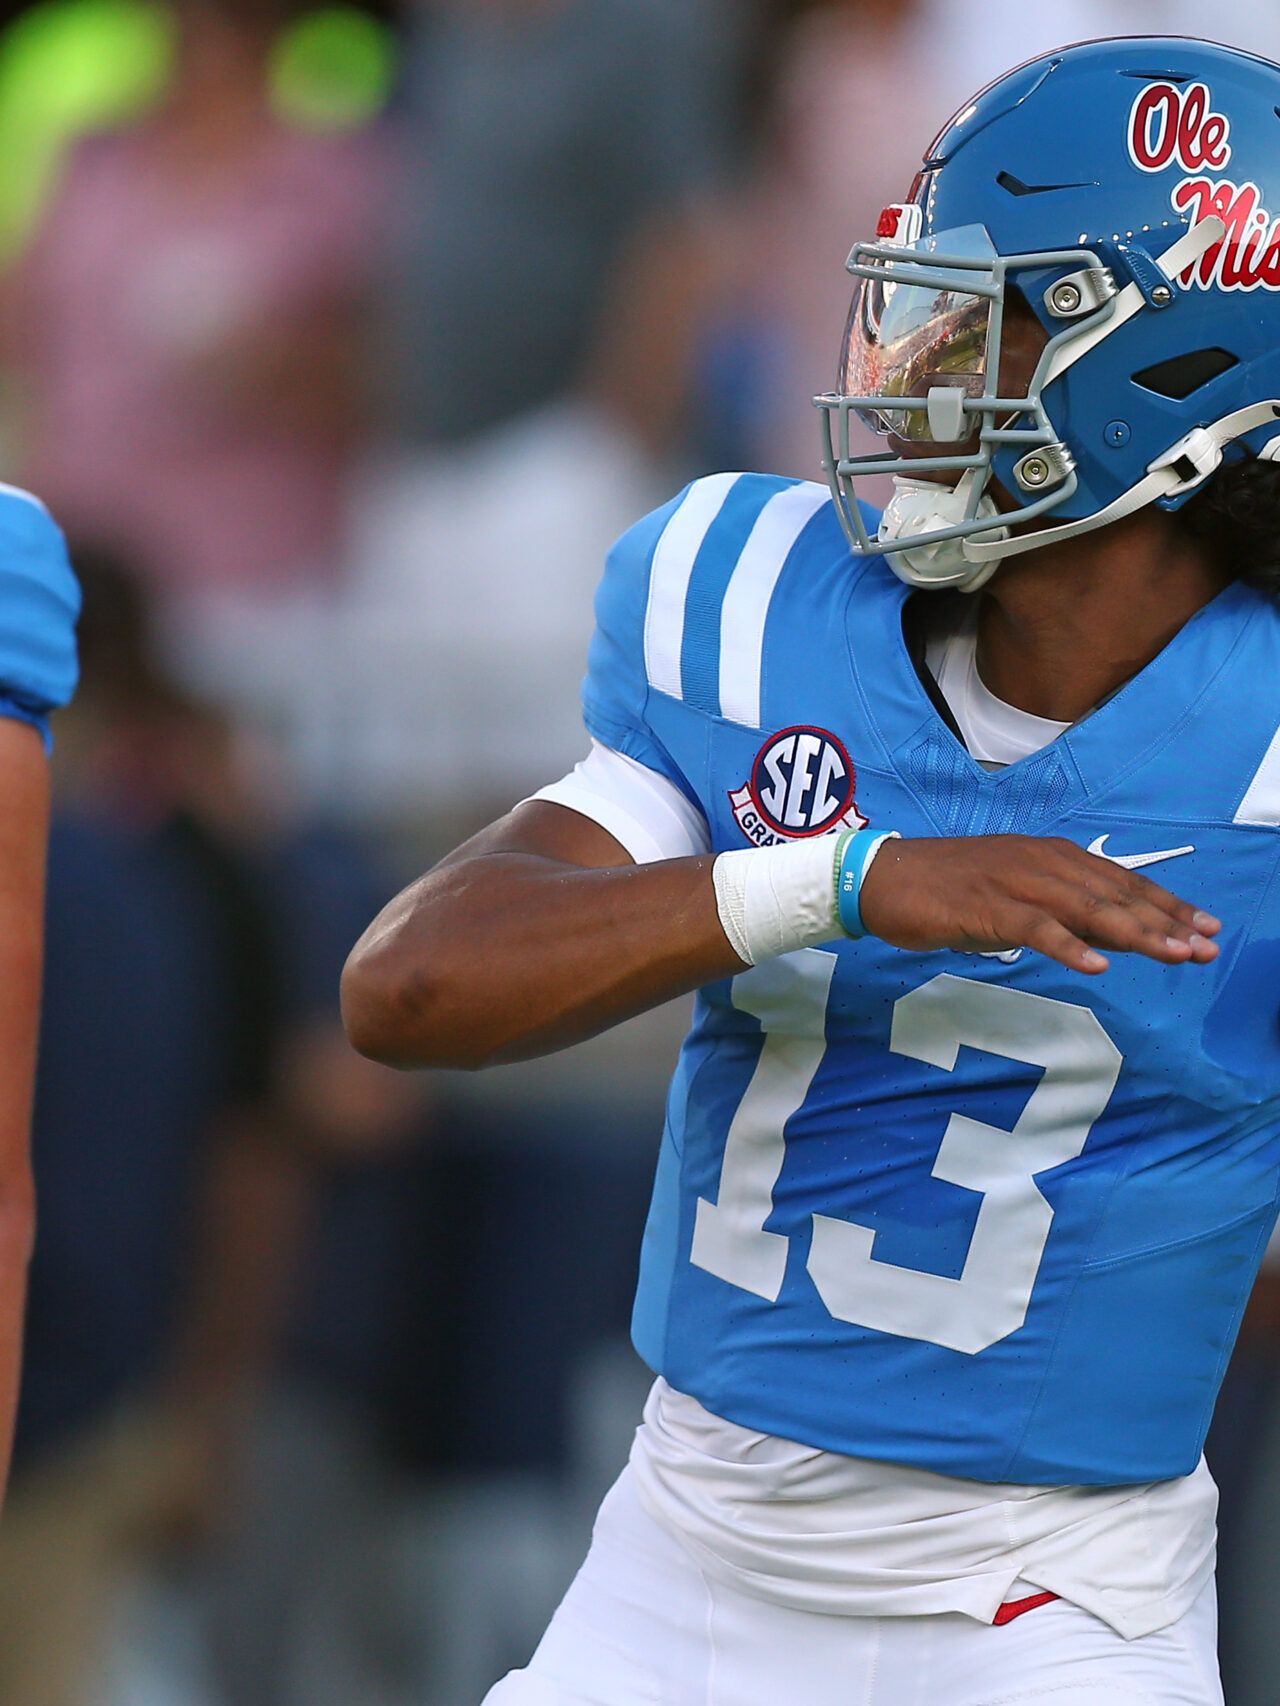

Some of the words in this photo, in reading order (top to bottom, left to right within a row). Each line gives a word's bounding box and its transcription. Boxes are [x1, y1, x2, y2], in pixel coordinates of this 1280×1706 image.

[1128, 82, 1231, 173] Ole
[760, 734, 846, 827] SEC
[843, 871, 855, 892] #16
[690, 947, 1123, 1355] 13
